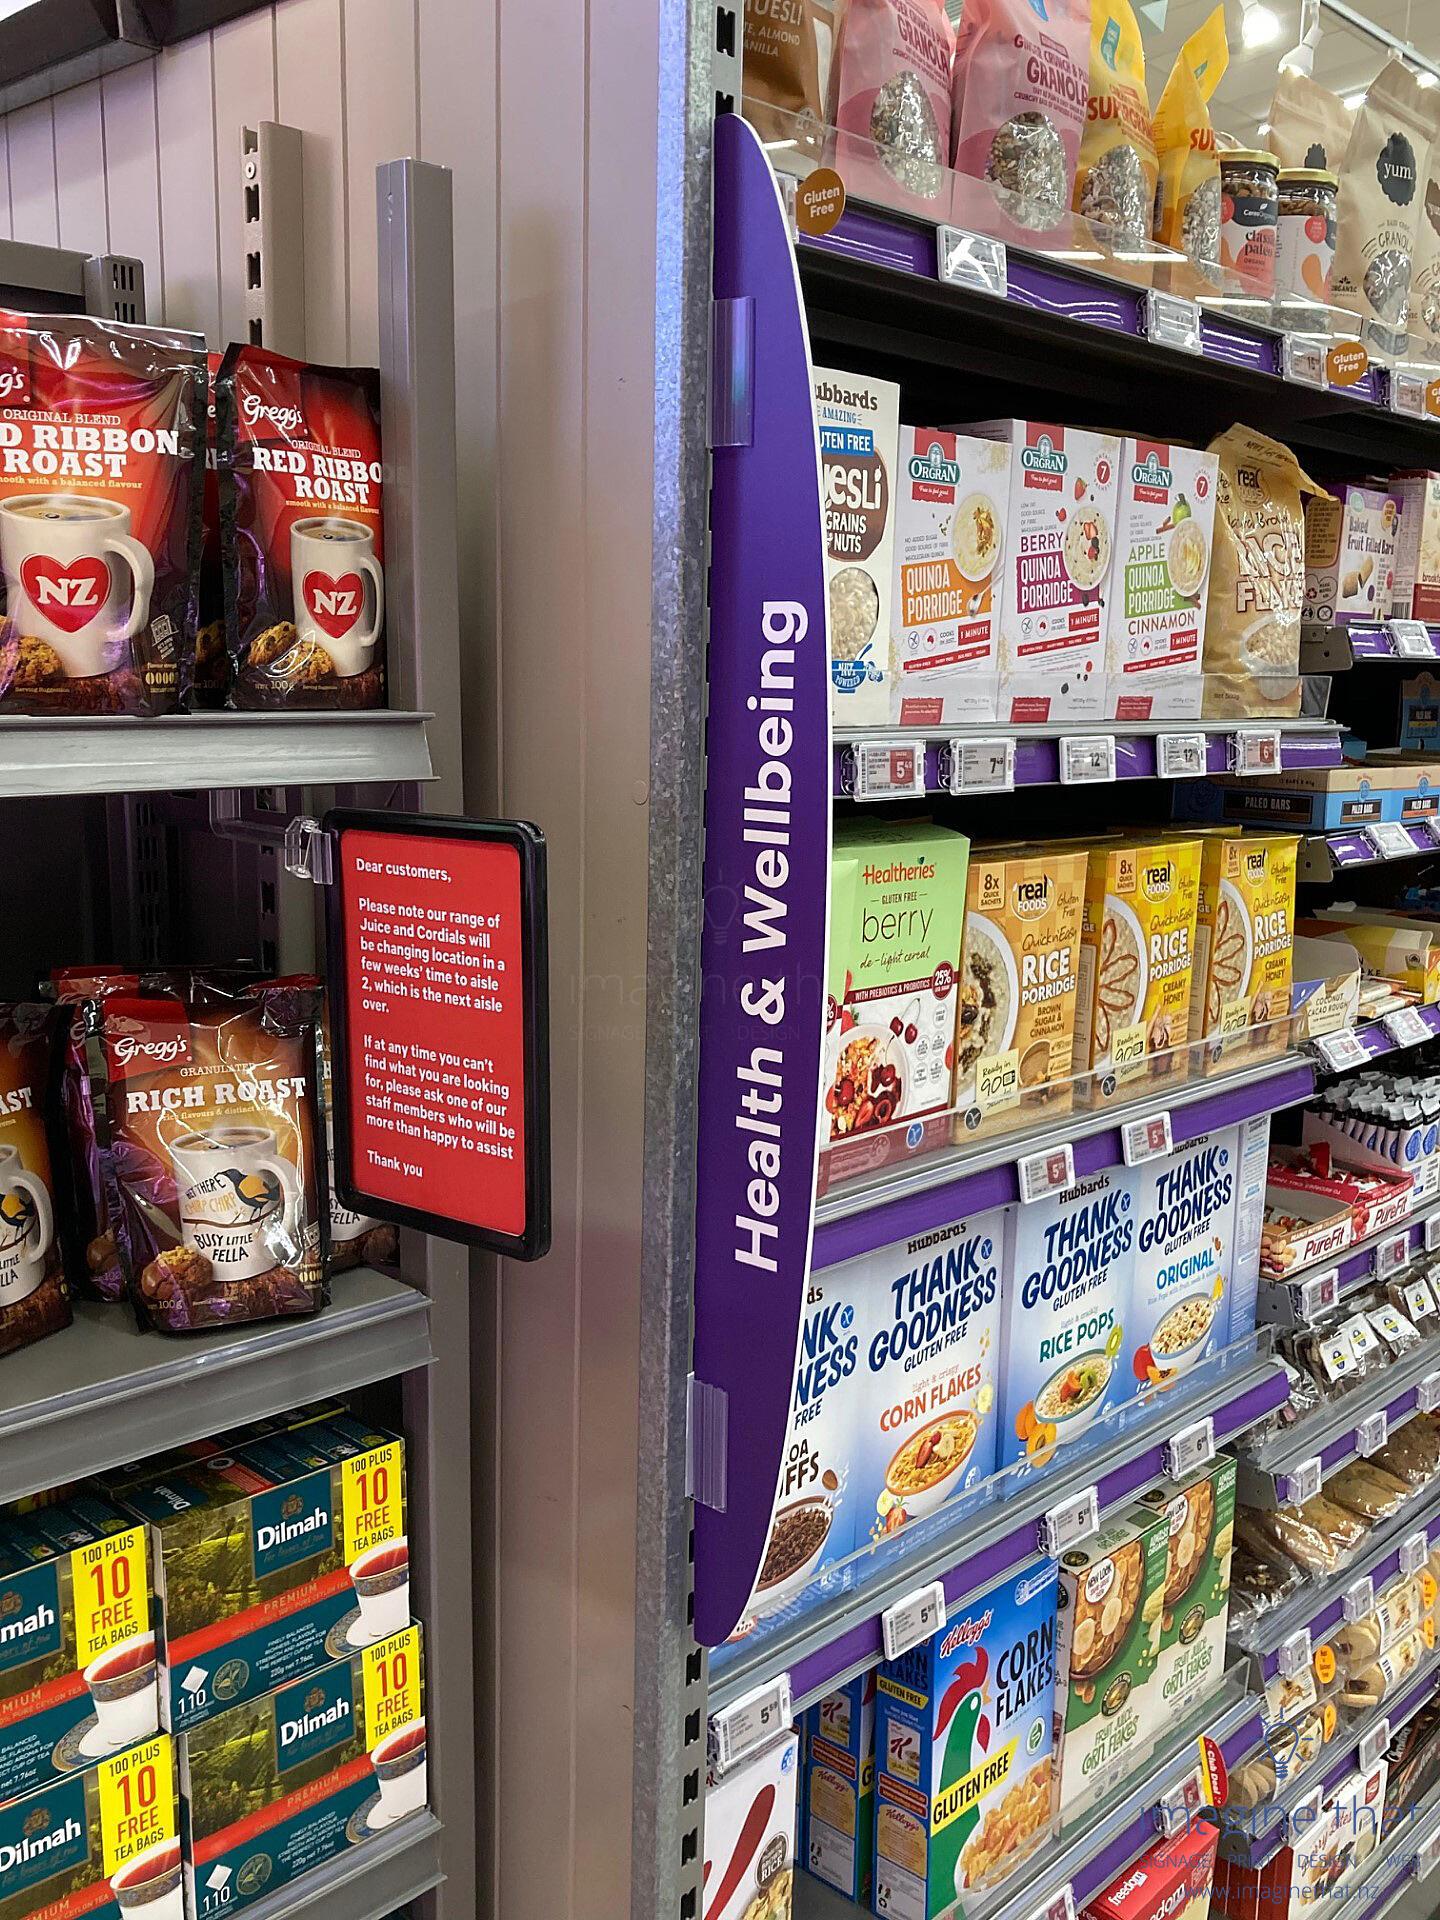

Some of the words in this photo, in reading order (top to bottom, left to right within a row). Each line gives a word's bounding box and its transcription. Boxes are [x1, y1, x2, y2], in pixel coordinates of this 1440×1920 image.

[759, 26, 800, 45] ALMOND
[898, 13, 949, 78] GRANOLA
[804, 187, 840, 205] Gluten
[810, 203, 835, 218] Free
[815, 382, 878, 411] ubbards
[3, 408, 71, 423] ORIGINAL
[75, 413, 120, 425] BLEND
[242, 395, 303, 429] Gregg's
[32, 424, 179, 456] RIBBON
[848, 433, 871, 452] FREE
[3, 448, 126, 478] ROAST
[252, 447, 306, 474] RED
[312, 454, 383, 484] RIBBO
[911, 460, 957, 482] ORGRAN
[1237, 466, 1259, 488] real
[28, 476, 50, 486] with
[60, 479, 105, 488] balanced
[108, 480, 143, 490] flavour
[294, 475, 369, 505] ROAST
[826, 511, 867, 534] GRAINS
[834, 534, 862, 553] NUTS
[1021, 532, 1064, 552] BERRY
[1128, 543, 1166, 563] APPLE
[1347, 534, 1364, 550] Fruit
[905, 563, 951, 592] QUINOA
[1021, 554, 1062, 583] QUINOA
[1128, 567, 1165, 589] QUINOA
[35, 576, 98, 607] NZ
[312, 588, 357, 616] NZ
[907, 589, 963, 623] PORRIDGE
[1022, 581, 1073, 609] PORRIDGE
[966, 626, 988, 638] MINUTE
[1128, 611, 1195, 636] CINNAMON
[743, 600, 808, 954] Wellbeing
[1245, 797, 1269, 808] PALEO
[1271, 797, 1291, 810] BARS
[356, 858, 382, 873] Dear
[386, 864, 452, 883] customers,
[863, 859, 936, 885] Healtheries
[984, 873, 1000, 890] 8x
[981, 897, 1002, 906] SACHETS
[983, 890, 999, 898] QUICK
[1017, 874, 1048, 901] real
[359, 898, 396, 915] Please
[399, 905, 424, 919] note
[427, 910, 447, 921] our
[450, 911, 484, 929] range
[488, 914, 500, 928] of
[1017, 899, 1047, 912] FOODS
[360, 918, 391, 934] Juice
[393, 923, 414, 938] and
[417, 925, 466, 945] Cordials
[469, 933, 490, 949] will
[862, 908, 934, 943] berry
[1254, 909, 1286, 943] RICE
[361, 936, 375, 951] be
[377, 939, 429, 962] changing
[432, 947, 480, 967] location
[483, 954, 494, 969] in
[497, 959, 505, 971] a
[904, 946, 931, 962] cereal
[1150, 927, 1189, 964] RICE
[361, 956, 382, 972] few
[426, 967, 452, 984] time
[455, 972, 467, 986] to
[470, 975, 499, 991] aisle
[934, 968, 952, 986] 25%
[1022, 947, 1071, 987] RICE
[363, 998, 389, 1013] over.
[374, 980, 406, 996] which
[410, 984, 419, 999] is
[423, 986, 442, 1003] the
[445, 990, 471, 1008] next
[474, 996, 503, 1013] aisle
[741, 976, 784, 1024] &
[855, 991, 869, 1003] WITH
[870, 985, 897, 999] PREBIOTICS
[903, 979, 930, 992] PROBIOTICS
[1038, 1003, 1061, 1016] BROWN
[374, 1038, 385, 1051] at
[388, 1042, 408, 1059] any
[411, 1045, 436, 1062] time
[439, 1052, 460, 1068] you
[365, 1054, 386, 1071] find
[389, 1061, 416, 1077] what
[419, 1068, 440, 1083] you
[442, 1072, 460, 1086] are
[464, 1074, 509, 1100] looking
[982, 1064, 1003, 1078] Ready
[126, 1084, 205, 1114] RICH
[386, 1079, 421, 1098] please
[424, 1087, 444, 1103] ask
[447, 1093, 468, 1108] one
[471, 1098, 483, 1111] of
[486, 1102, 507, 1117] our
[366, 1094, 391, 1111] staff
[393, 1098, 445, 1124] members
[448, 1112, 472, 1130] who
[475, 1120, 496, 1135] will
[499, 1125, 515, 1139] be
[366, 1114, 394, 1131] more
[396, 1119, 420, 1138] than
[423, 1125, 458, 1149] happy
[461, 1135, 474, 1151] to
[477, 1141, 514, 1160] assist
[367, 1150, 400, 1171] Thank
[403, 1161, 423, 1177] you
[735, 1048, 783, 1274] Health
[1156, 1145, 1219, 1211] THANK
[1044, 1189, 1122, 1264] THANK
[1139, 1173, 1232, 1253] GOODNESS
[194, 1233, 223, 1249] BUSY
[227, 1233, 252, 1245] LITTLE
[1304, 1227, 1345, 1261] PureFit
[892, 1235, 981, 1320] THANK
[1021, 1219, 1133, 1309] GOODNESS
[1157, 1248, 1214, 1291] ORIGINAL
[869, 1266, 997, 1373] GOODNESS
[1077, 1308, 1115, 1342] POPS
[880, 1395, 926, 1432] CORN
[930, 1363, 982, 1409] FLAKES
[350, 1458, 366, 1475] 100
[369, 1448, 392, 1467] PLUS
[356, 1467, 388, 1511] 10
[257, 1507, 328, 1552] Dilmah
[355, 1505, 391, 1535] FREE
[352, 1539, 369, 1552] TEA
[371, 1526, 394, 1544] BAGS
[81, 1546, 102, 1566] 100
[90, 1556, 130, 1608] 10
[264, 1583, 318, 1614] PREMIUM
[940, 1608, 994, 1659] Kellogg's
[280, 1697, 350, 1747] Dilmah
[1108, 1869, 1146, 1907] freedom
